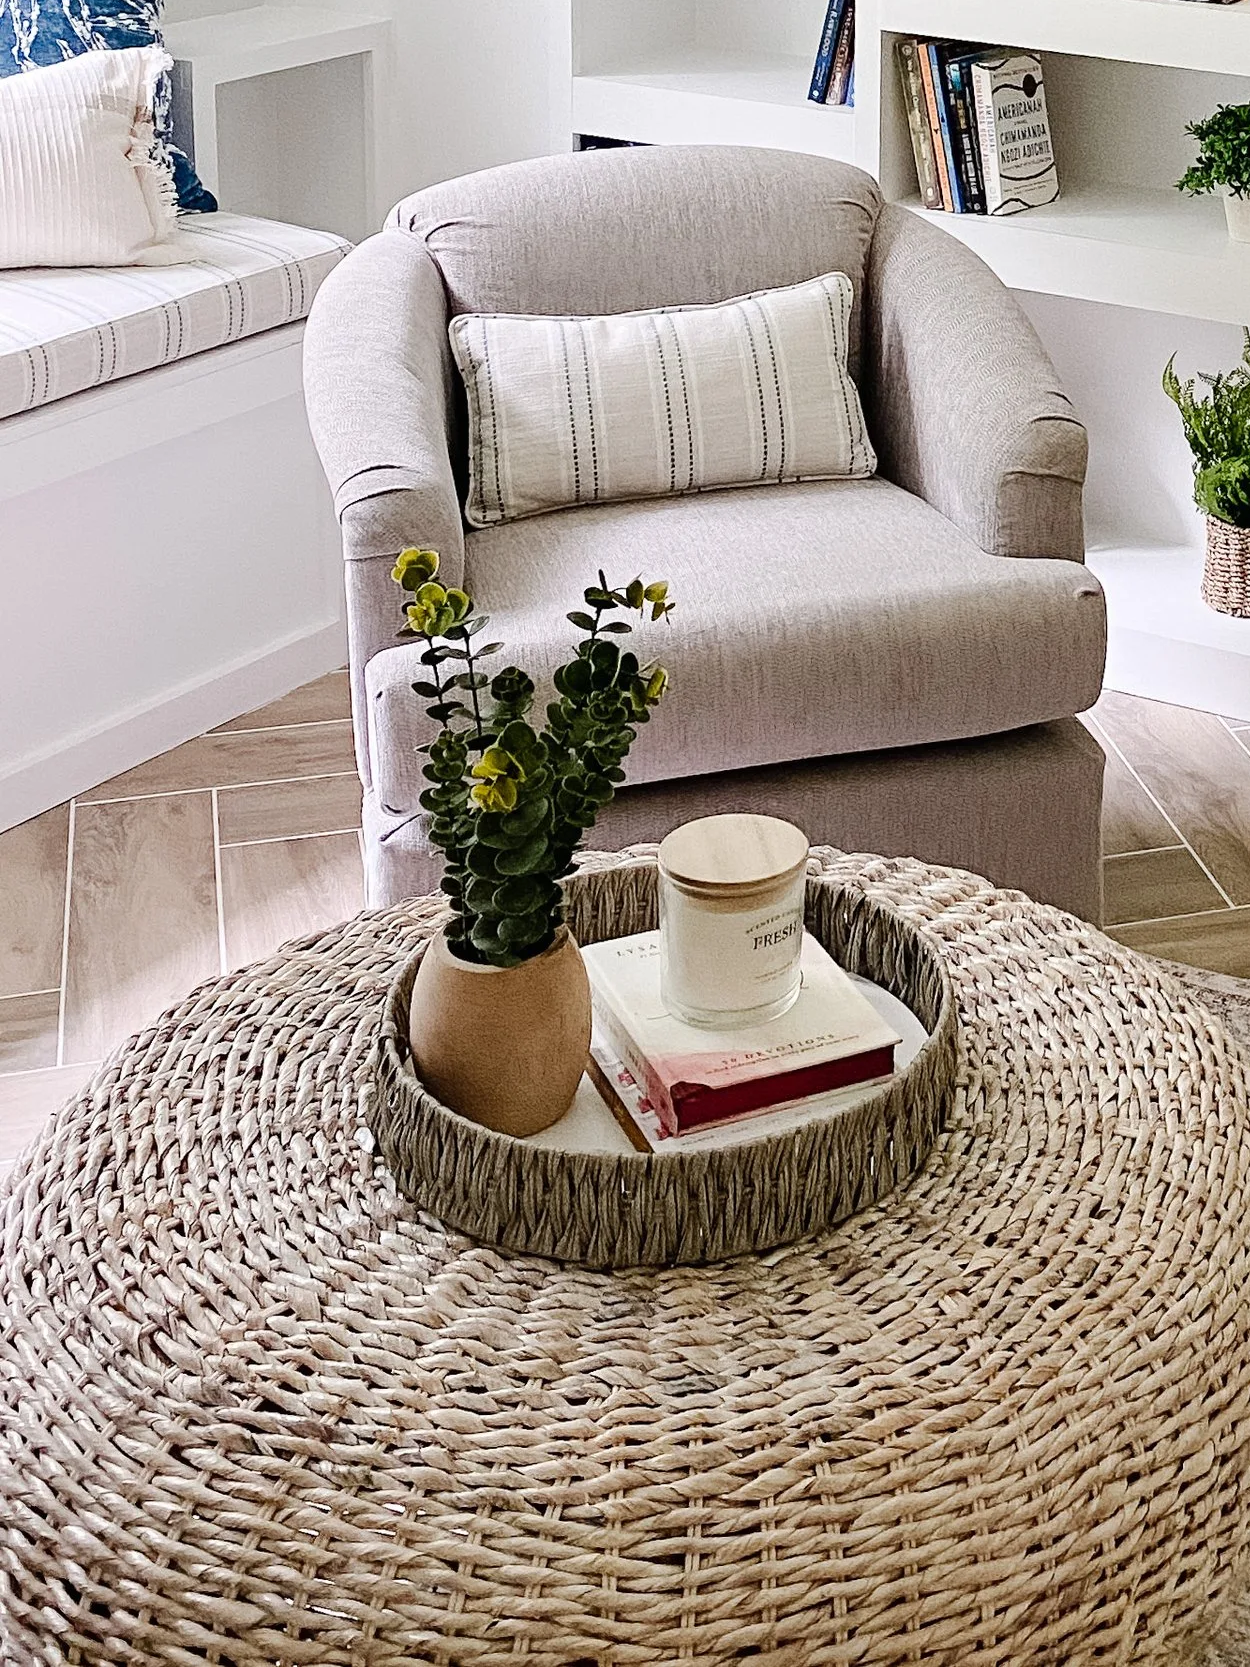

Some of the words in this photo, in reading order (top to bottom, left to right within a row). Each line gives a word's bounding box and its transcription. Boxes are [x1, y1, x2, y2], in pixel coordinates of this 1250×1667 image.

[998, 98, 1043, 121] AMERICANAH
[984, 104, 996, 154] AMERICANAH
[999, 123, 1047, 146] CHIMAMANDA
[752, 920, 799, 951] FRESH
[616, 943, 658, 957] LYSA
[744, 1033, 836, 1060] DEVOTIONS
